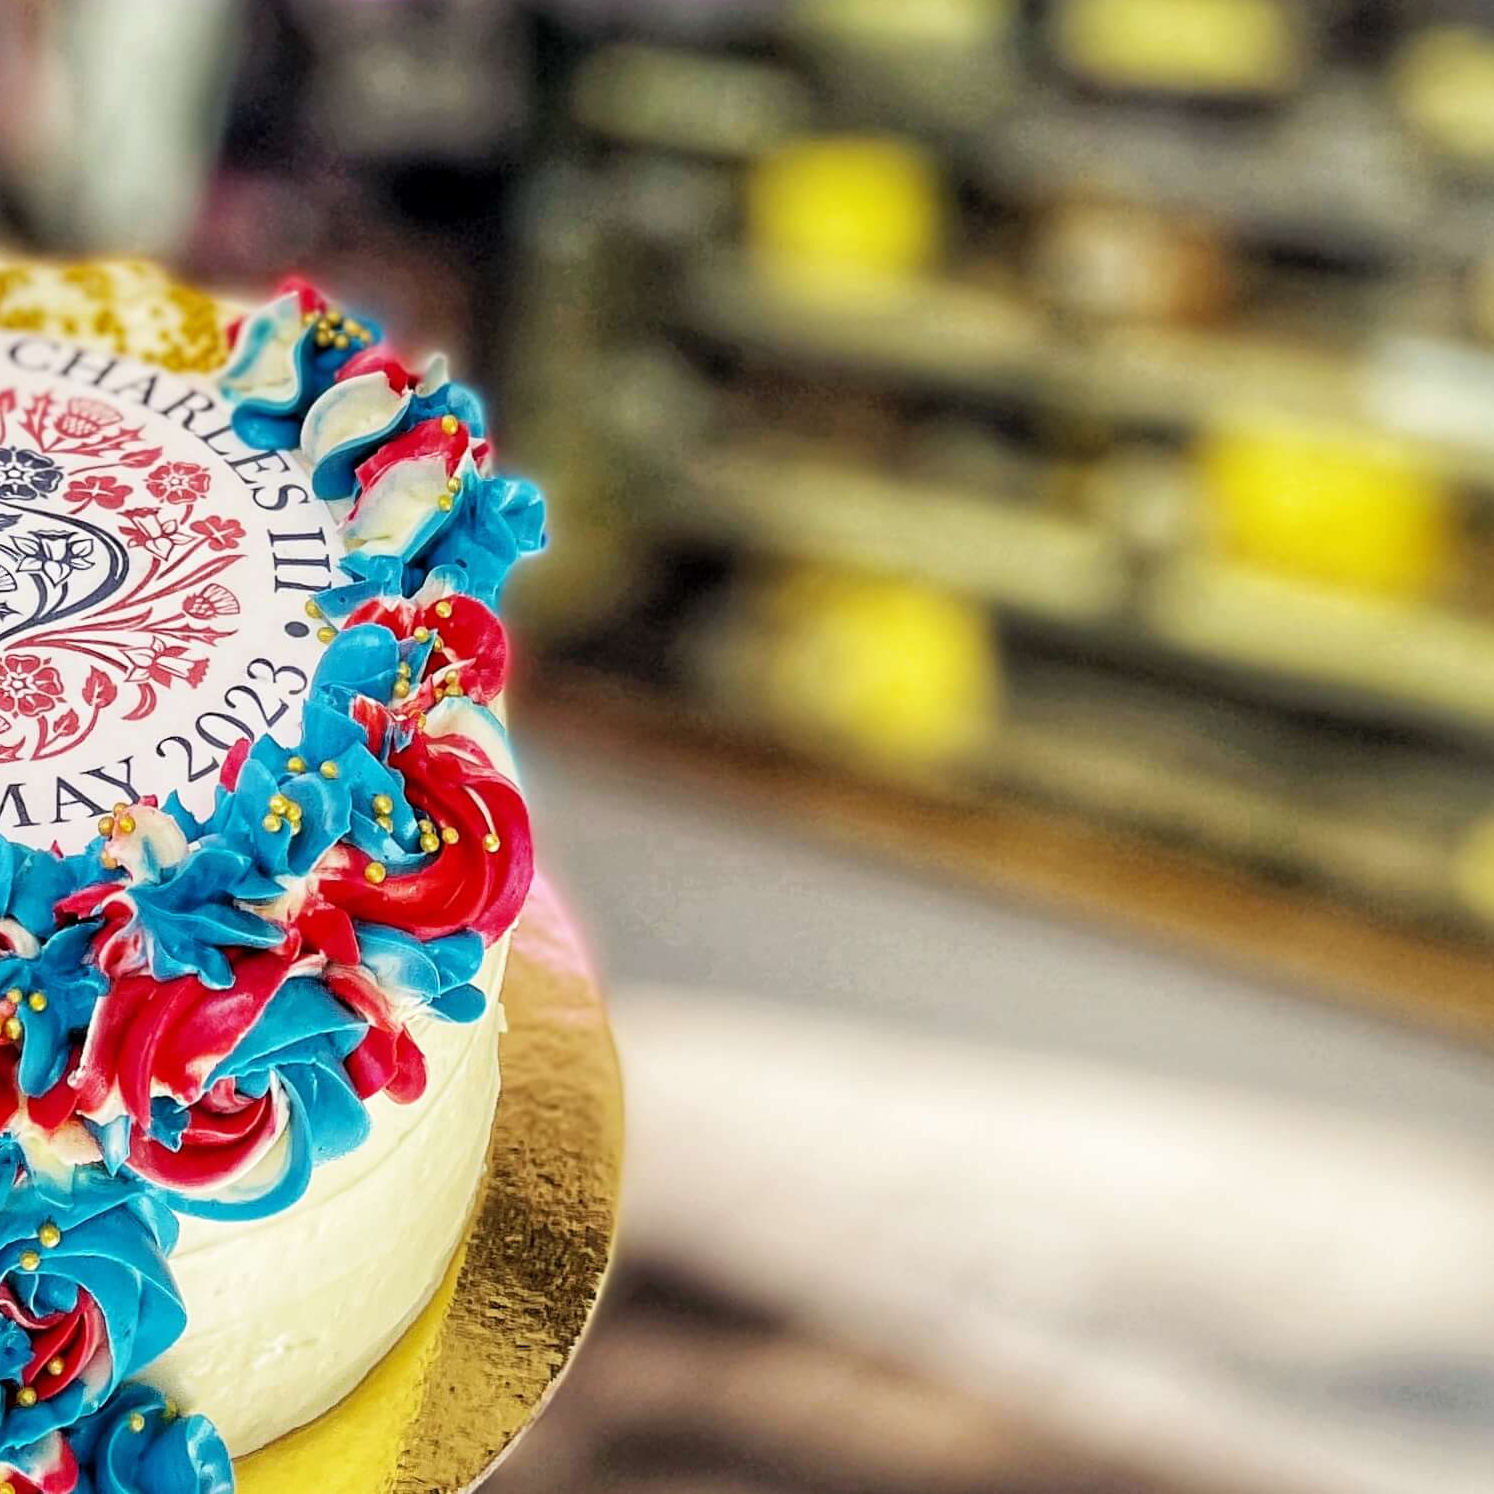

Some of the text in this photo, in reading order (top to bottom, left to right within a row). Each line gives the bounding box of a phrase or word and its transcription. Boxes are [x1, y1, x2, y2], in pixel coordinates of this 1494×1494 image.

[8, 337, 311, 511] CHARLES
[266, 526, 333, 594] III
[155, 657, 308, 783] 2023
